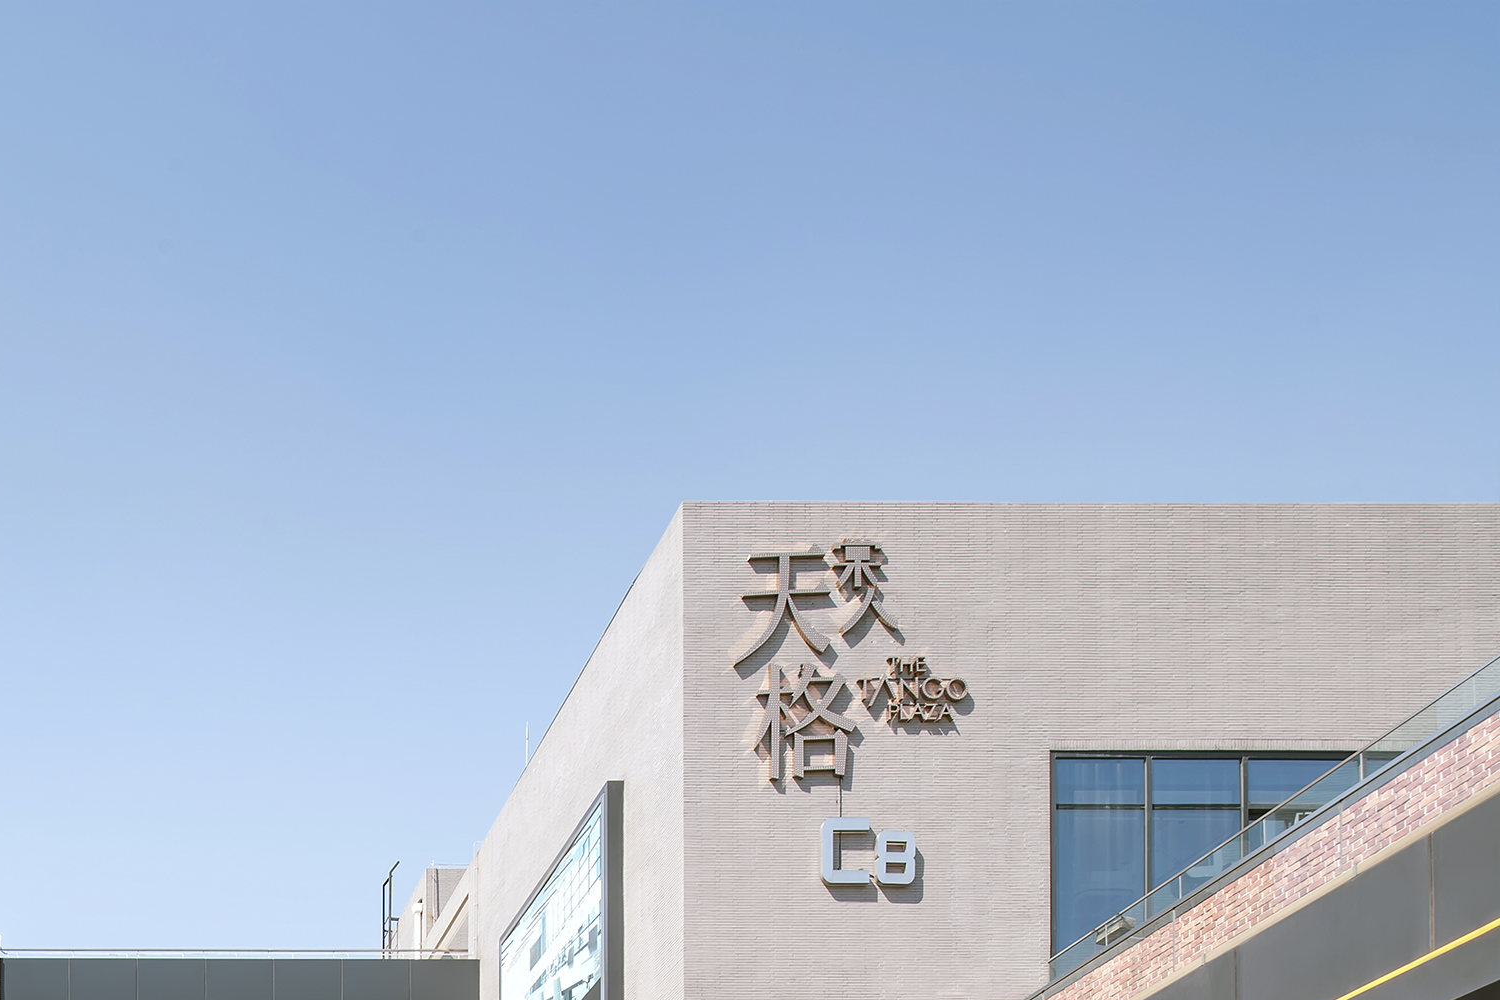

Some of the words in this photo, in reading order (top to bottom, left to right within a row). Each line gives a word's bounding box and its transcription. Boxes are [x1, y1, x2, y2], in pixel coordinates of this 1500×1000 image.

[886, 656, 927, 675] THE
[856, 673, 968, 709] TANGO
[887, 702, 954, 723] PLAZA
[820, 816, 916, 885] C8
